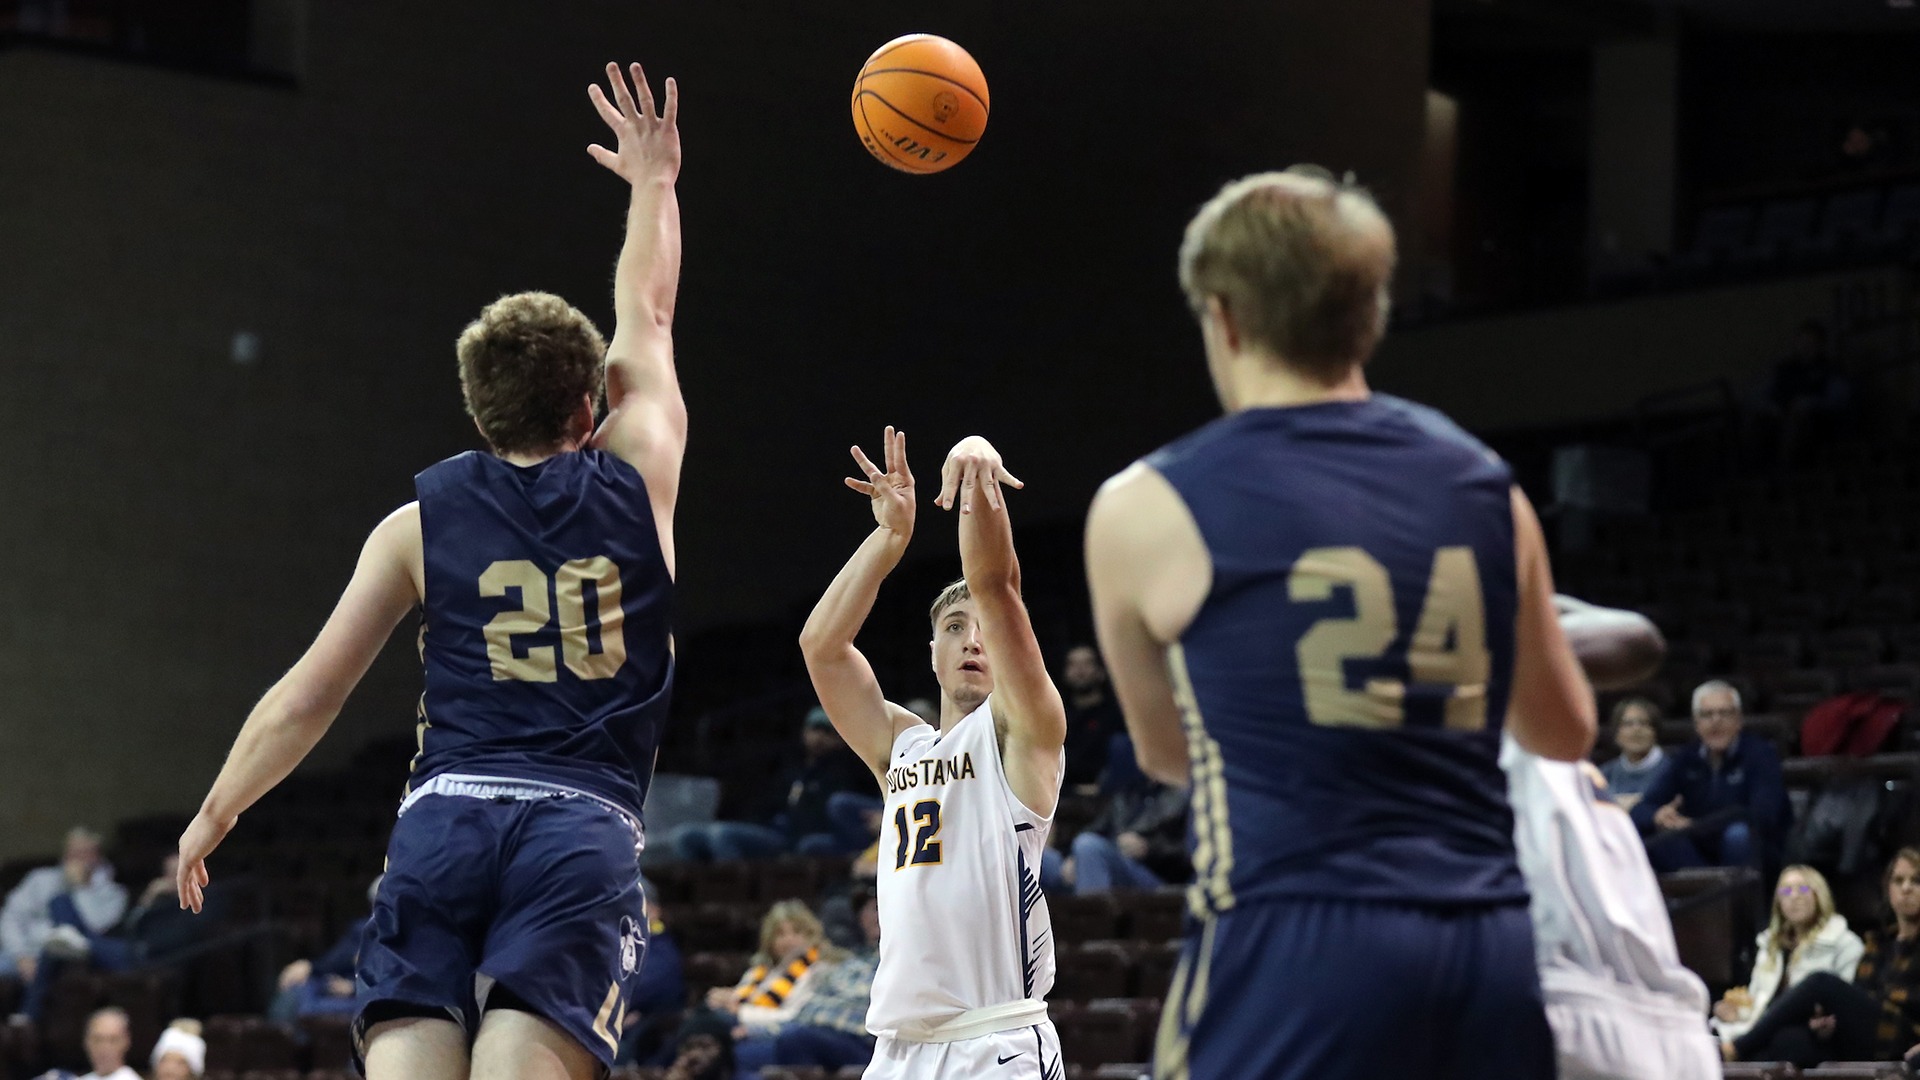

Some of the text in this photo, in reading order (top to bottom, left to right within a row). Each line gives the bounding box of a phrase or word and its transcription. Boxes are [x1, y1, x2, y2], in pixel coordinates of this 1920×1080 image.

[478, 555, 627, 682] 20
[1288, 546, 1491, 731] 24
[894, 798, 943, 872] 12
